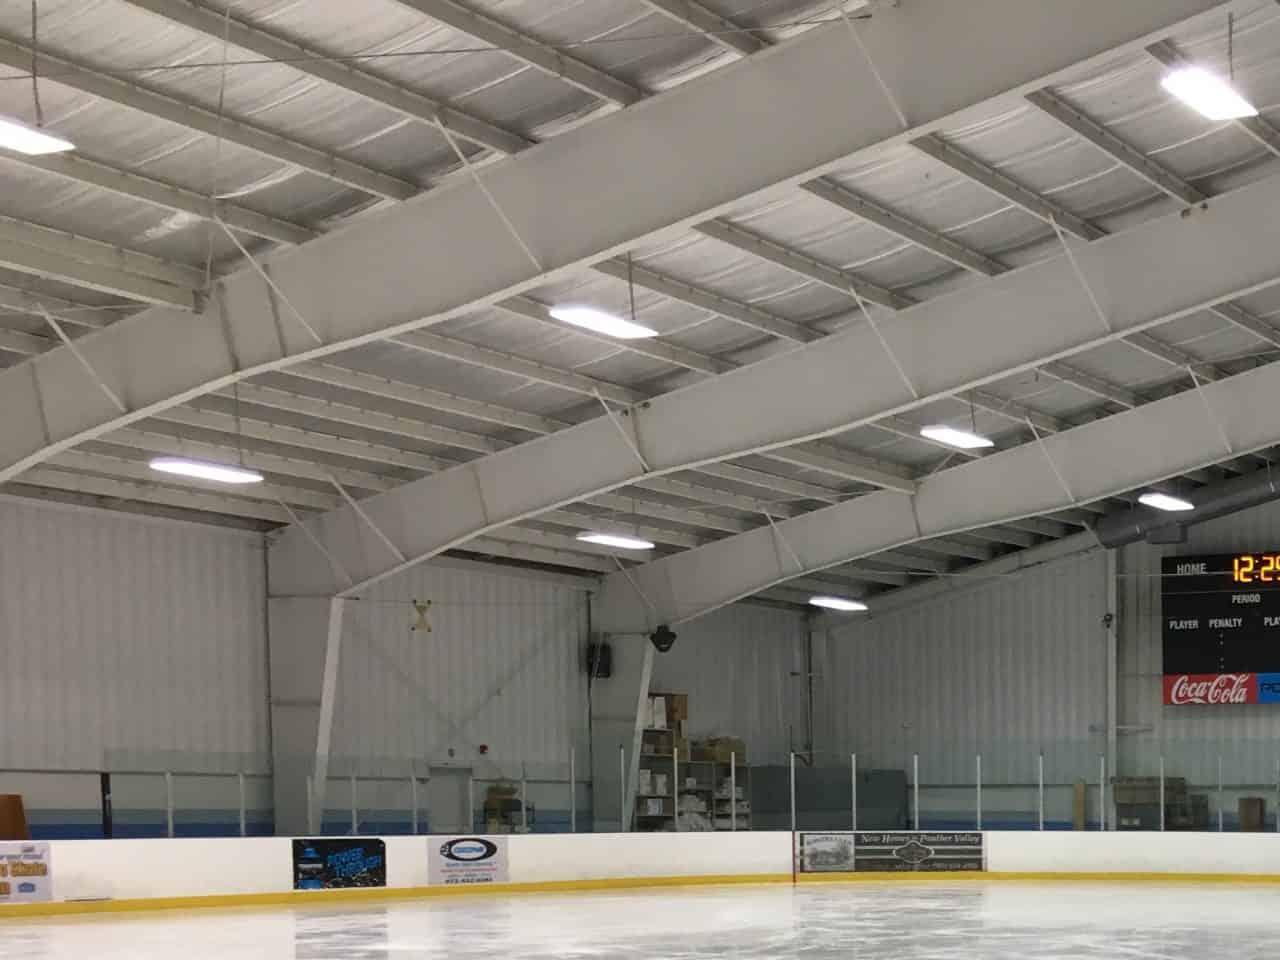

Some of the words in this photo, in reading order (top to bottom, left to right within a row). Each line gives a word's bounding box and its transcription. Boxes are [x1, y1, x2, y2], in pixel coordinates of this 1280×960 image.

[1176, 563, 1208, 576] HOME
[1231, 593, 1261, 604] PERIOD
[1169, 619, 1199, 630] PLAYER
[1208, 617, 1243, 629] PENALTY
